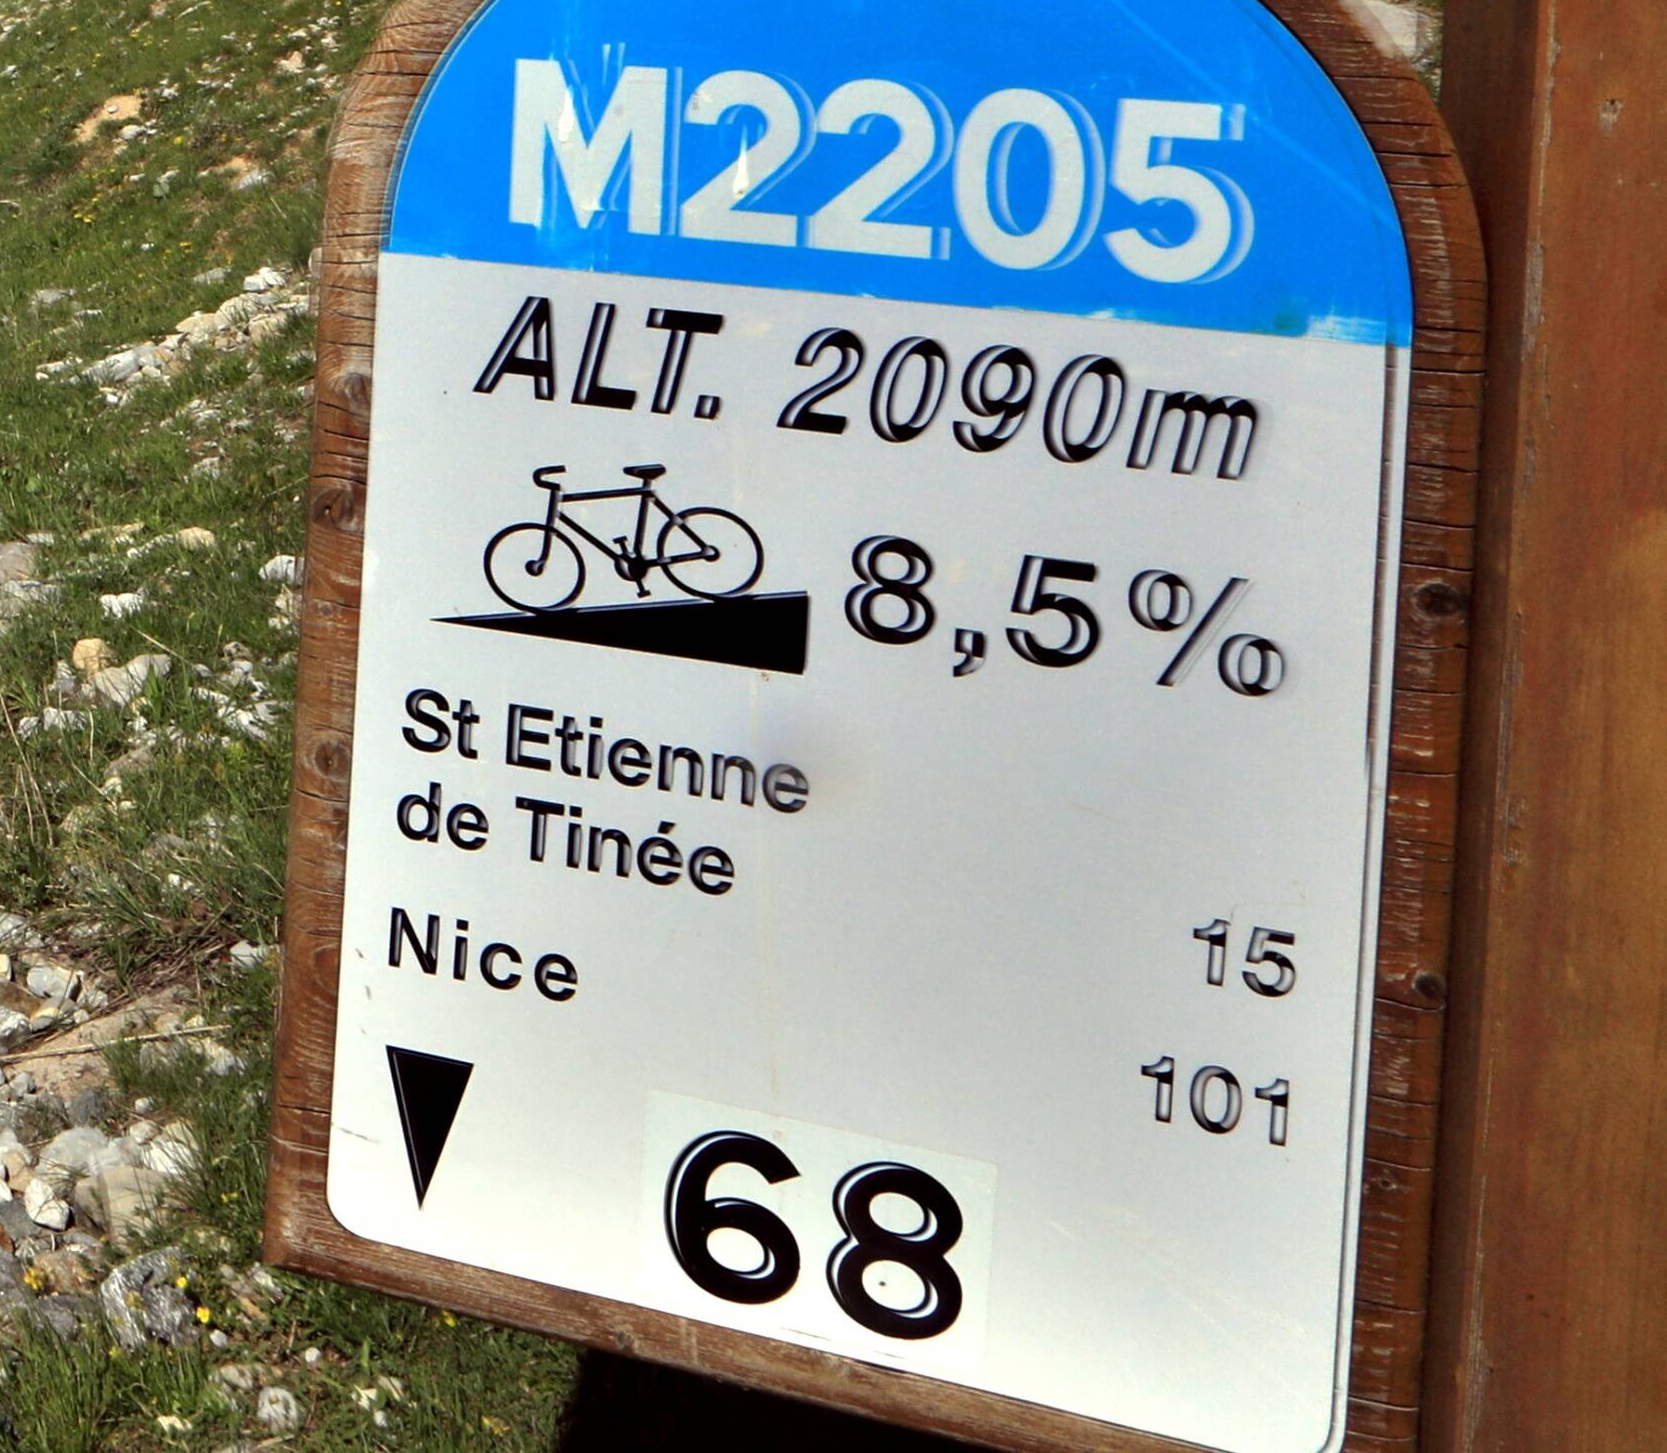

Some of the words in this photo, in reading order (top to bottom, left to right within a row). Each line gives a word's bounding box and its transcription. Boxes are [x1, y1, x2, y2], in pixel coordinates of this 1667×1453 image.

[508, 57, 1255, 284] M2205
[473, 296, 725, 421] ALT.
[778, 327, 1261, 481] 2090m
[843, 535, 1288, 698] 8,5%
[401, 688, 480, 759] St
[504, 704, 811, 815] Etienne
[397, 783, 490, 851] de
[516, 799, 736, 895] Tinée
[387, 907, 580, 1002] Nice
[1192, 918, 1298, 999] 15
[1140, 1055, 1292, 1147] 101
[664, 1130, 964, 1340] 68
